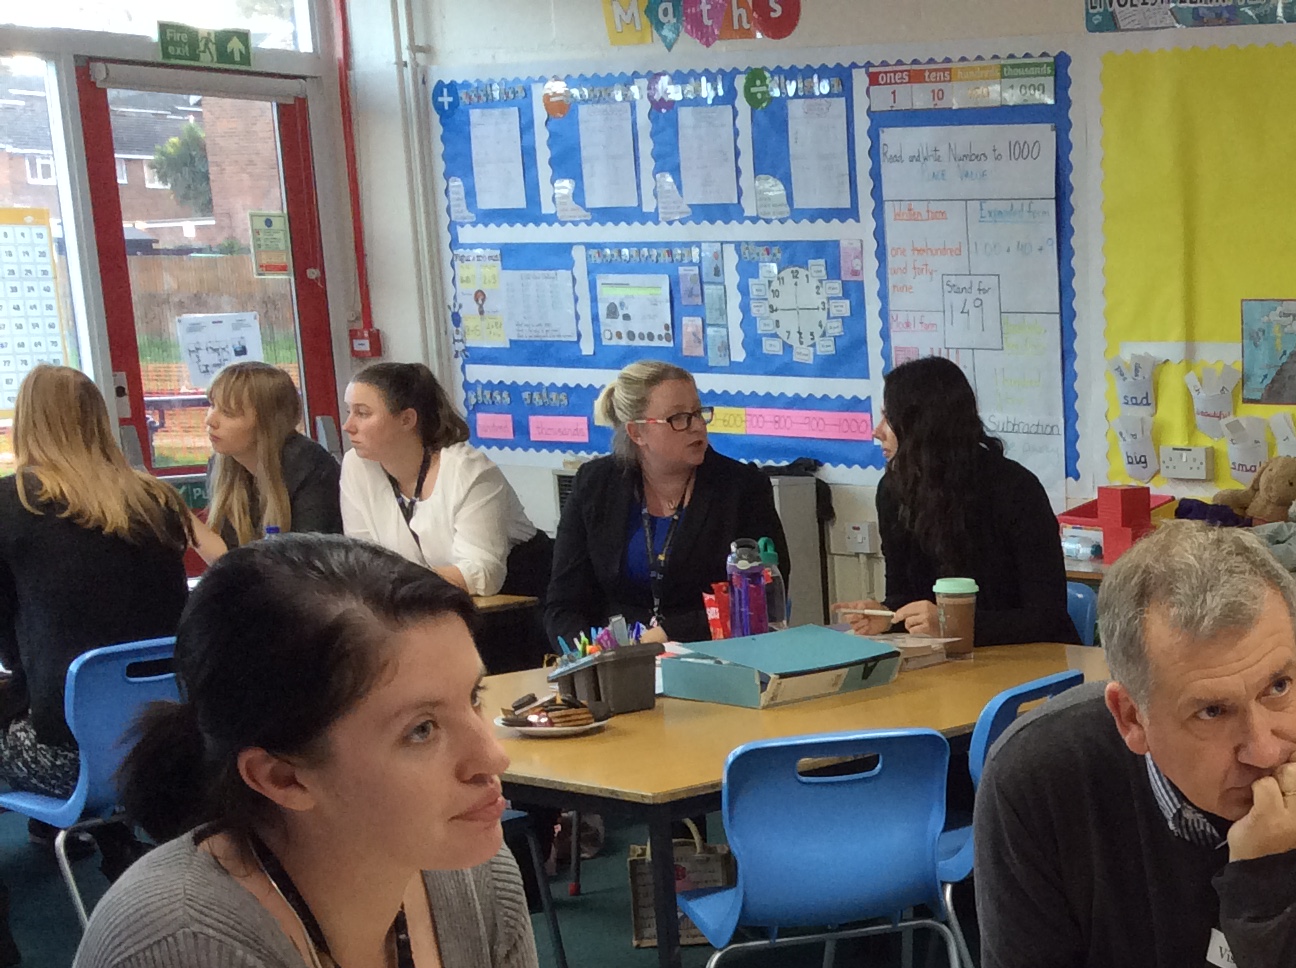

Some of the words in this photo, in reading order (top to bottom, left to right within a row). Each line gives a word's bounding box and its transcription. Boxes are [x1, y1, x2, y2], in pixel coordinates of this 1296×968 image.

[614, 0, 783, 32] Maths
[166, 29, 188, 42] Fire
[168, 45, 189, 57] exit
[878, 71, 909, 84] ones
[924, 70, 950, 82] tens
[1003, 64, 1052, 77] thousands
[891, 90, 897, 104] 1
[931, 89, 944, 102] 10
[882, 144, 903, 164] Read
[948, 142, 988, 162] Numbers
[993, 145, 1003, 161] to
[1008, 140, 1041, 161] 1000
[890, 263, 908, 276] and
[892, 283, 914, 294] nine
[946, 280, 973, 294] Stand
[977, 281, 992, 296] for
[950, 298, 984, 331] 149
[1122, 392, 1152, 406] sad
[774, 414, 793, 430] 800
[839, 418, 868, 433] 1000
[988, 415, 1060, 435] Subtraction
[1126, 452, 1148, 469] big
